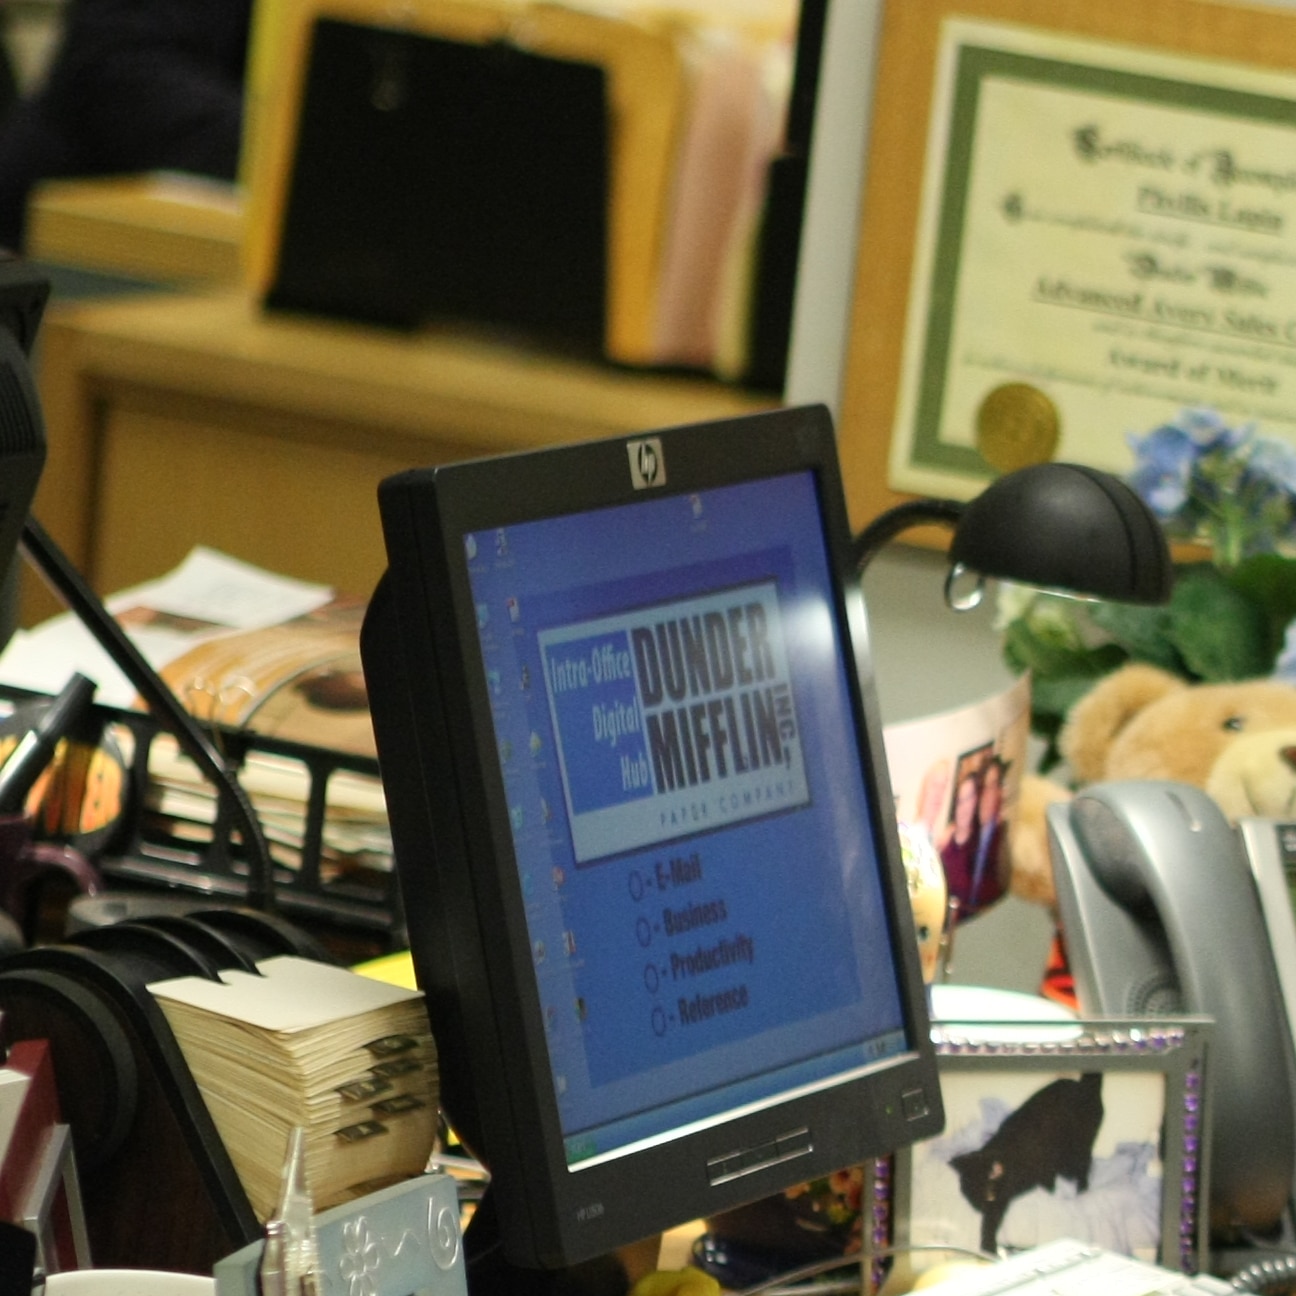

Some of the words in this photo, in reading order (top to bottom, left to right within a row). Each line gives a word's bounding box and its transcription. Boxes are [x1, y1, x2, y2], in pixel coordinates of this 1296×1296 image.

[550, 642, 632, 693] Intra-Office
[631, 602, 777, 708] DUNDER
[592, 696, 642, 748] Digital
[620, 753, 649, 792] Hub
[718, 779, 794, 814] COMPANY
[655, 852, 704, 891] E-Mail
[663, 898, 728, 938] Business
[670, 932, 755, 982] Productivity
[678, 983, 749, 1025] Reference
